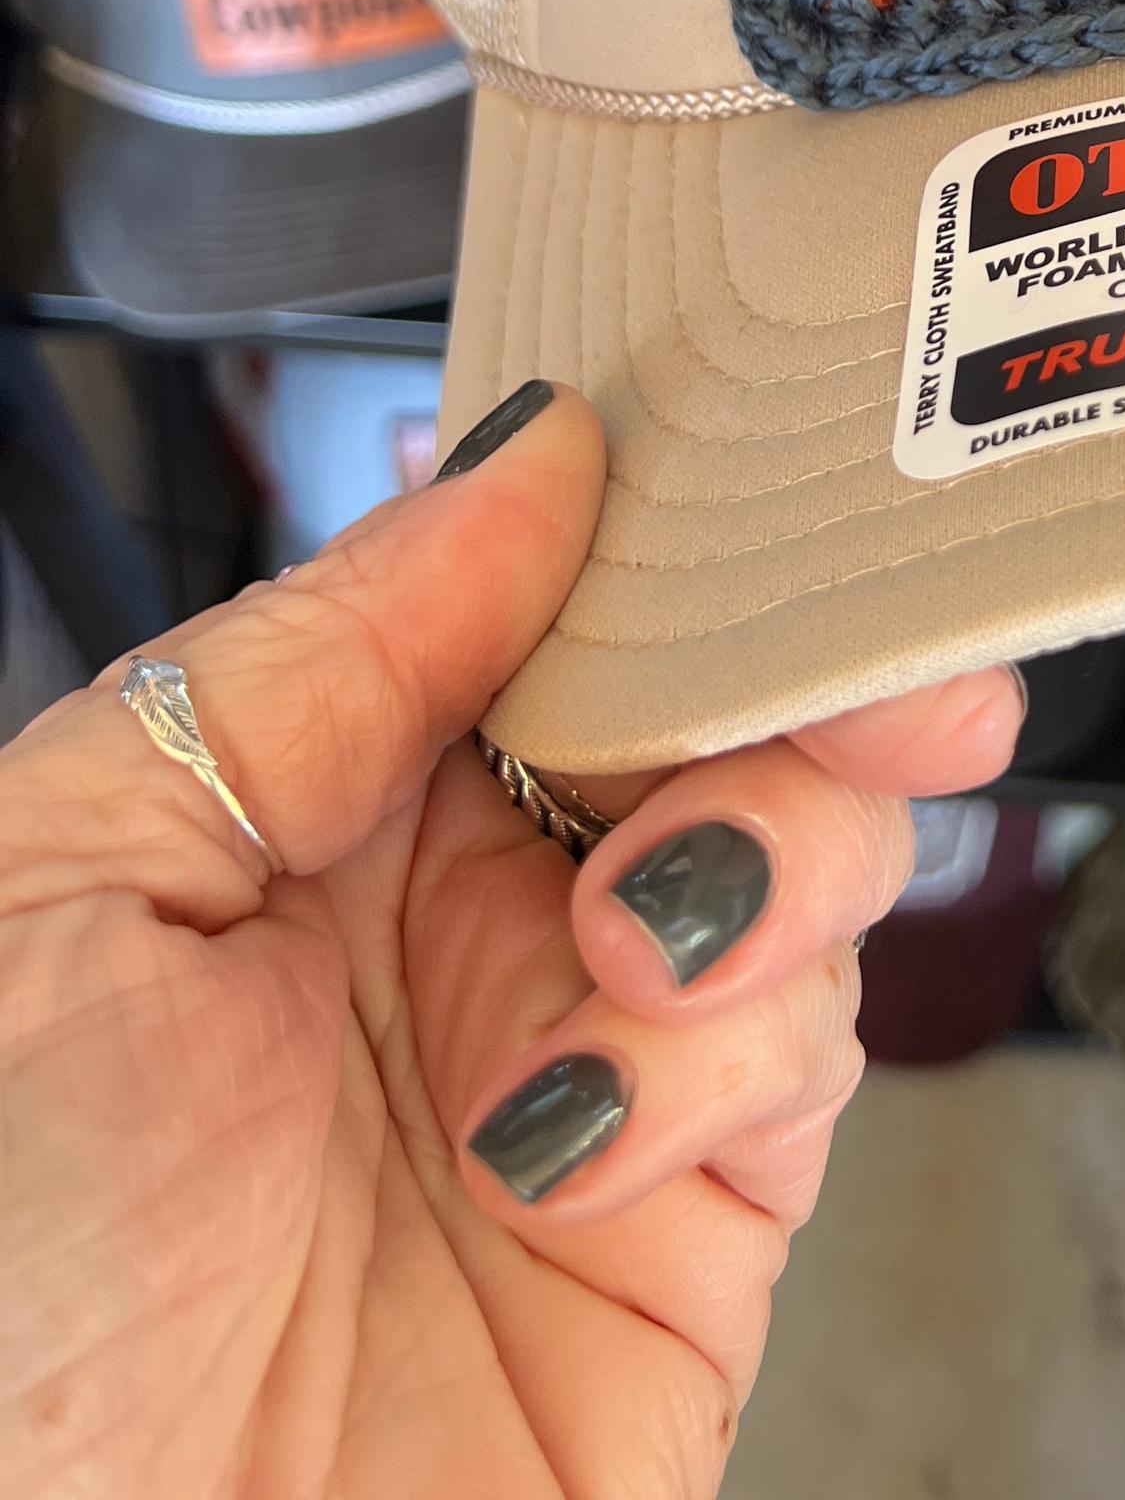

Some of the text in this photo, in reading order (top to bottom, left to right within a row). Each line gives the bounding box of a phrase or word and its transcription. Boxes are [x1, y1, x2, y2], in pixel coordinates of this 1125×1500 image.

[913, 180, 960, 436] TERRY CLOTH SWEATBAND
[969, 402, 1102, 455] DURABLE
